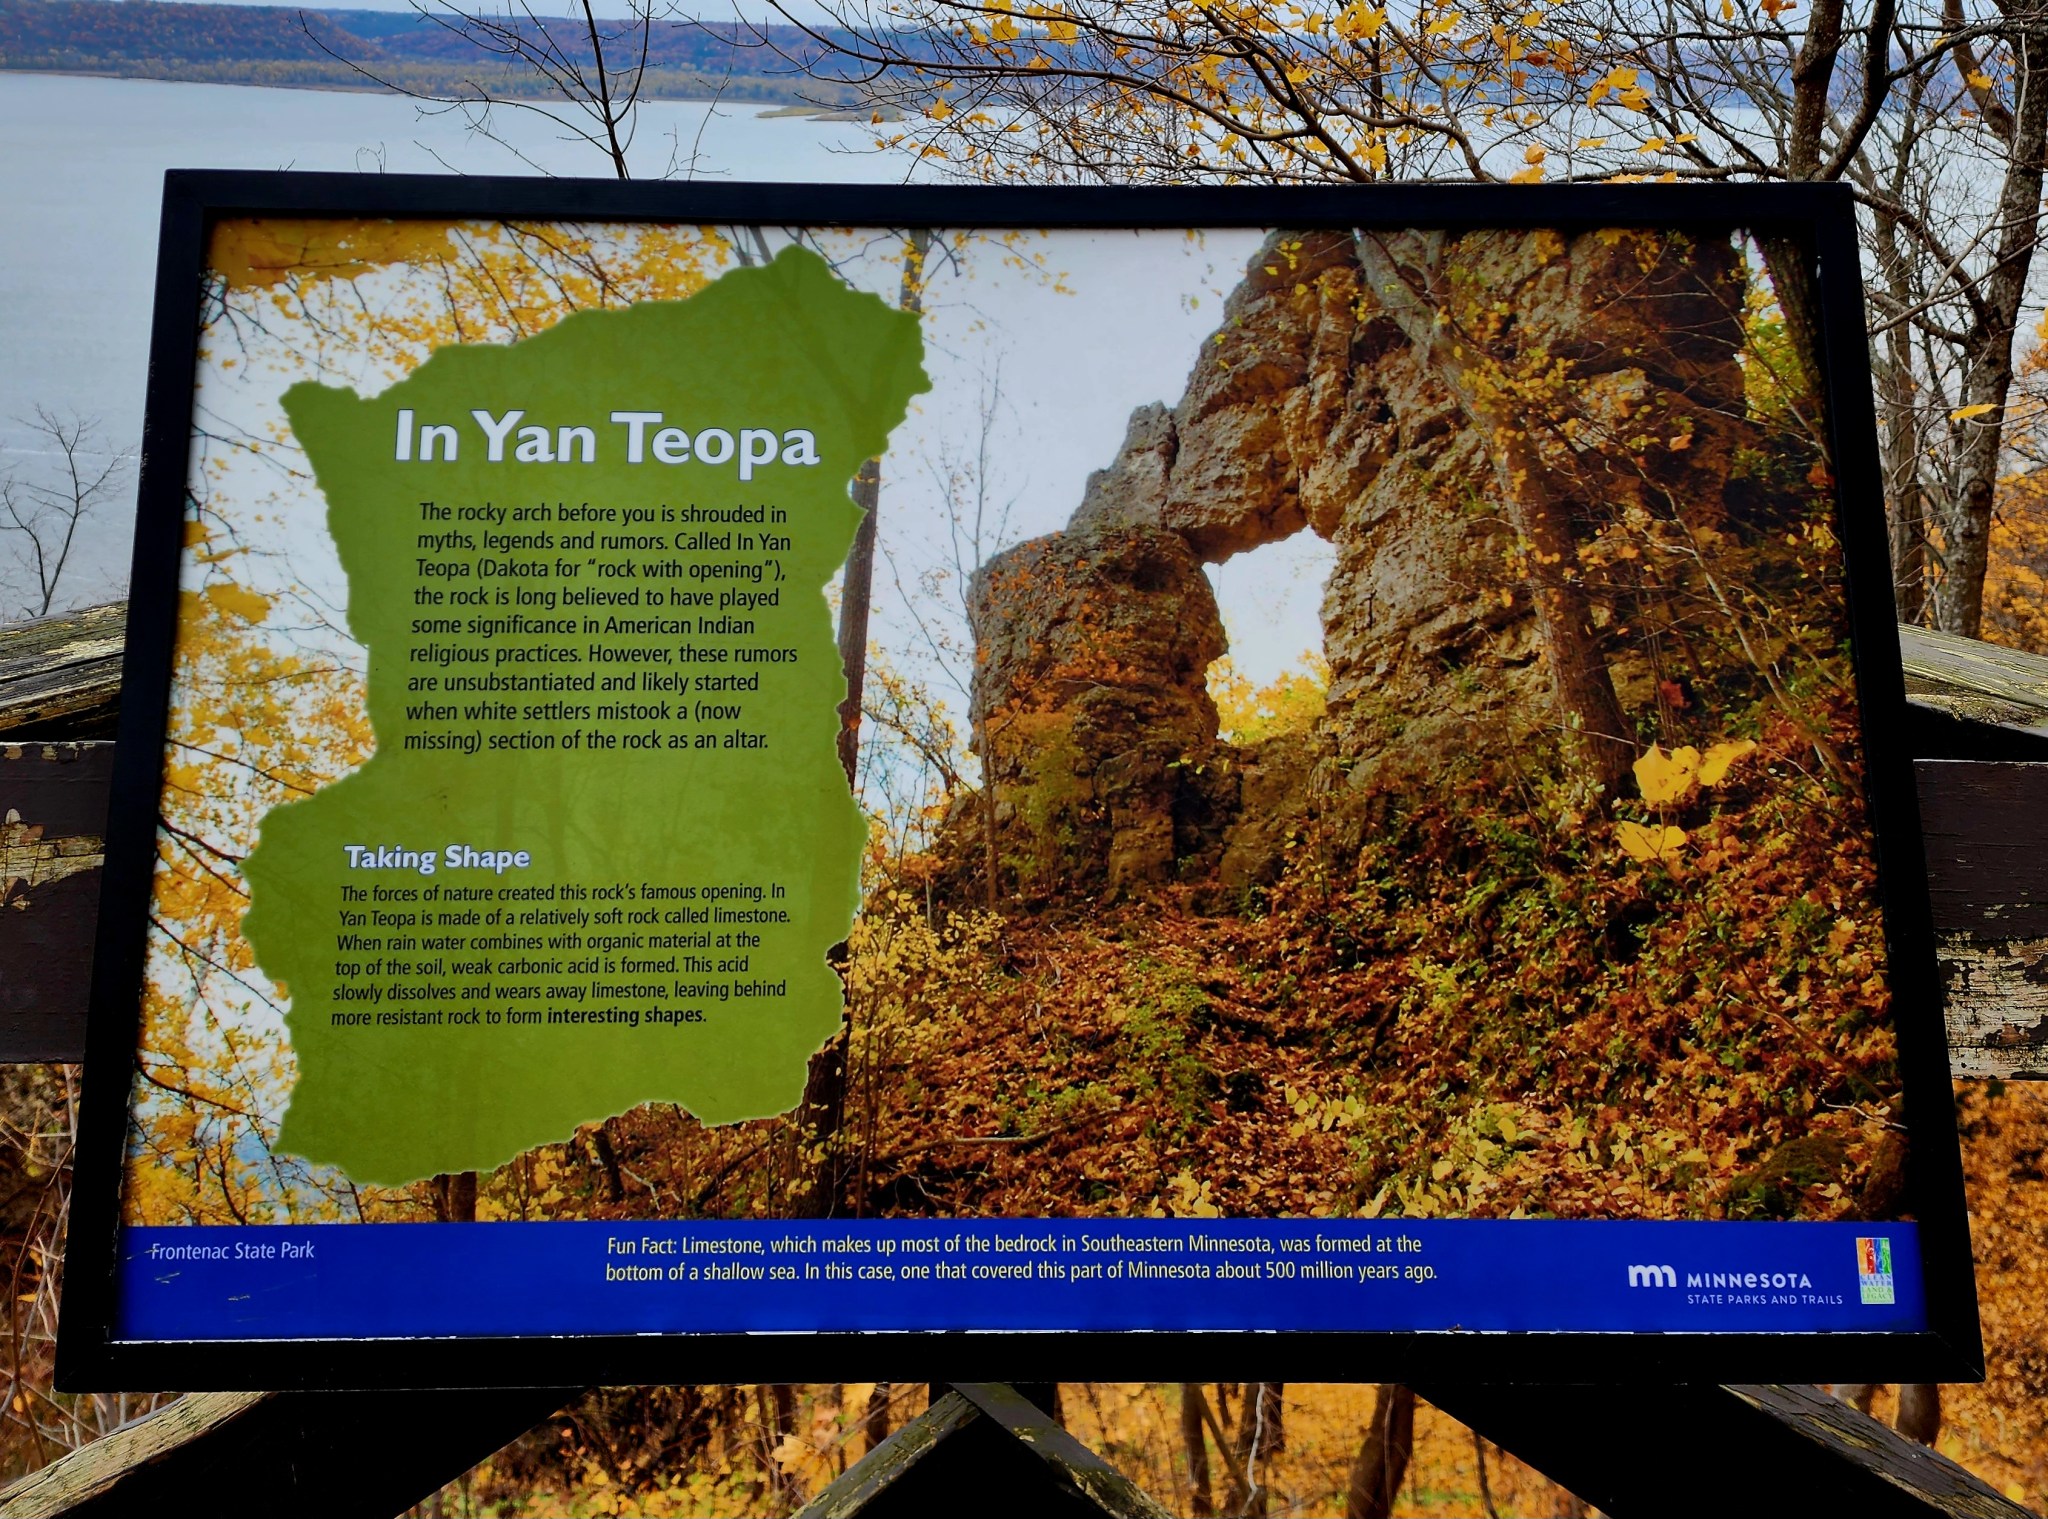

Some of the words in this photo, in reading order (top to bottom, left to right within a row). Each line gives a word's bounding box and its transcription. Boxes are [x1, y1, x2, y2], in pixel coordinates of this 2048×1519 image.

[394, 408, 459, 462] In
[470, 409, 597, 464] Yan
[609, 410, 822, 482] Teopa
[420, 502, 451, 520] The
[458, 502, 507, 526] rocky
[512, 503, 551, 521] arch
[558, 503, 616, 521] before
[622, 509, 654, 526] you
[662, 504, 675, 522] is
[681, 504, 764, 523] shrouded
[771, 505, 786, 523] in
[418, 530, 476, 553] myths,
[484, 530, 554, 554] legends
[560, 531, 594, 549] and
[601, 536, 668, 550] rumors.
[675, 531, 730, 550] Called
[738, 533, 753, 550] In
[759, 533, 790, 551] Yan
[416, 559, 470, 581] Teopa
[477, 558, 548, 579] (Dakota
[555, 558, 581, 577] for
[643, 559, 682, 578] with
[414, 586, 444, 605] the
[450, 586, 488, 605] rock
[496, 587, 509, 605] is
[516, 586, 556, 610] long
[563, 586, 639, 605] believed
[645, 590, 664, 606] to
[670, 587, 714, 606] have
[720, 587, 779, 611] played
[410, 643, 489, 667] religious
[496, 644, 582, 667] practices.
[589, 644, 672, 665] However,
[679, 643, 728, 662] these
[735, 649, 797, 662] rumors
[408, 677, 438, 691] are
[444, 672, 595, 691] unsubstantiated
[601, 672, 636, 691] and
[643, 672, 689, 696] likely
[695, 672, 758, 691] started
[404, 730, 482, 755] missing)
[489, 730, 555, 749] section
[562, 729, 581, 749] of
[586, 729, 616, 749] the
[623, 729, 661, 749] rock
[668, 735, 688, 749] as
[694, 735, 716, 748] an
[724, 729, 768, 748] altar.
[344, 845, 437, 875] Taking
[445, 845, 530, 874] Shape
[341, 885, 367, 902] The
[372, 884, 418, 901] forces
[423, 884, 440, 901] of
[444, 887, 493, 901] nature
[498, 884, 555, 901] created
[560, 884, 587, 900] this
[641, 883, 696, 899] famous
[701, 883, 766, 903] opening.
[772, 883, 785, 898] In
[339, 910, 366, 926] Yan
[371, 910, 416, 930] Teopa
[421, 910, 433, 926] is
[438, 909, 480, 926] made
[486, 908, 502, 925] of
[505, 913, 514, 925] a
[520, 908, 589, 928] relatively
[594, 907, 623, 924] soft
[628, 907, 659, 924] rock
[665, 907, 709, 923] called
[714, 907, 790, 923] limestone.
[337, 934, 381, 951] When
[387, 934, 416, 950] rain
[422, 936, 466, 950] water
[470, 933, 543, 950] combines
[548, 932, 581, 949] with
[587, 932, 644, 953] organic
[649, 931, 711, 948] material
[716, 933, 731, 948] at
[736, 931, 760, 947] the
[335, 961, 361, 980] top
[366, 958, 383, 975] of
[386, 958, 411, 975] the
[416, 958, 446, 977] soil,
[451, 958, 492, 975] weak
[498, 957, 563, 974] carbonic
[568, 957, 599, 974] acid
[604, 957, 615, 973] is
[621, 956, 679, 973] formed.
[683, 956, 712, 972] This
[718, 955, 748, 972] acid
[331, 1013, 372, 1026] more
[376, 1008, 443, 1025] resistant
[448, 1007, 480, 1024] rock
[485, 1009, 501, 1024] to
[506, 1007, 542, 1024] form
[548, 1006, 639, 1027] interesting
[645, 1006, 706, 1027] shapes.
[151, 1243, 230, 1260] Frontenac
[235, 1242, 276, 1259] State
[281, 1240, 315, 1258] Park
[608, 1237, 636, 1254] Fun
[642, 1237, 677, 1254] Fact:
[683, 1236, 765, 1255] Limestone,
[770, 1235, 816, 1253] which
[822, 1235, 871, 1253] makes
[877, 1240, 896, 1257] up
[901, 1237, 940, 1252] most
[944, 1234, 961, 1252] of
[965, 1234, 990, 1252] the
[995, 1234, 1057, 1252] bedrock
[1062, 1235, 1076, 1251] in
[1081, 1234, 1183, 1252] Southeastern
[1189, 1234, 1275, 1254] Minnesota,
[1280, 1239, 1311, 1252] was
[1315, 1234, 1371, 1252] formed
[1376, 1237, 1392, 1252] at
[1396, 1234, 1422, 1252] the
[606, 1263, 663, 1281] bottom
[668, 1262, 685, 1280] of
[689, 1267, 698, 1280] a
[704, 1262, 764, 1280] shallow
[769, 1266, 799, 1280] sea.
[806, 1262, 819, 1279] In
[825, 1261, 853, 1279] this
[858, 1266, 895, 1281] case,
[901, 1266, 930, 1279] one
[935, 1261, 967, 1279] that
[972, 1260, 1032, 1279] covered
[1037, 1260, 1065, 1278] this
[1071, 1263, 1102, 1283] part
[1107, 1260, 1123, 1278] of
[1128, 1261, 1210, 1278] Minnesota
[1216, 1260, 1261, 1278] about
[1266, 1261, 1295, 1278] 500
[1301, 1260, 1353, 1278] million
[1358, 1266, 1399, 1283] years
[1404, 1266, 1437, 1283] ago.
[1688, 1294, 1723, 1304] STATE
[1728, 1295, 1767, 1304] PARKS
[1771, 1295, 1797, 1304] AND
[1802, 1295, 1843, 1304] TRAILS
